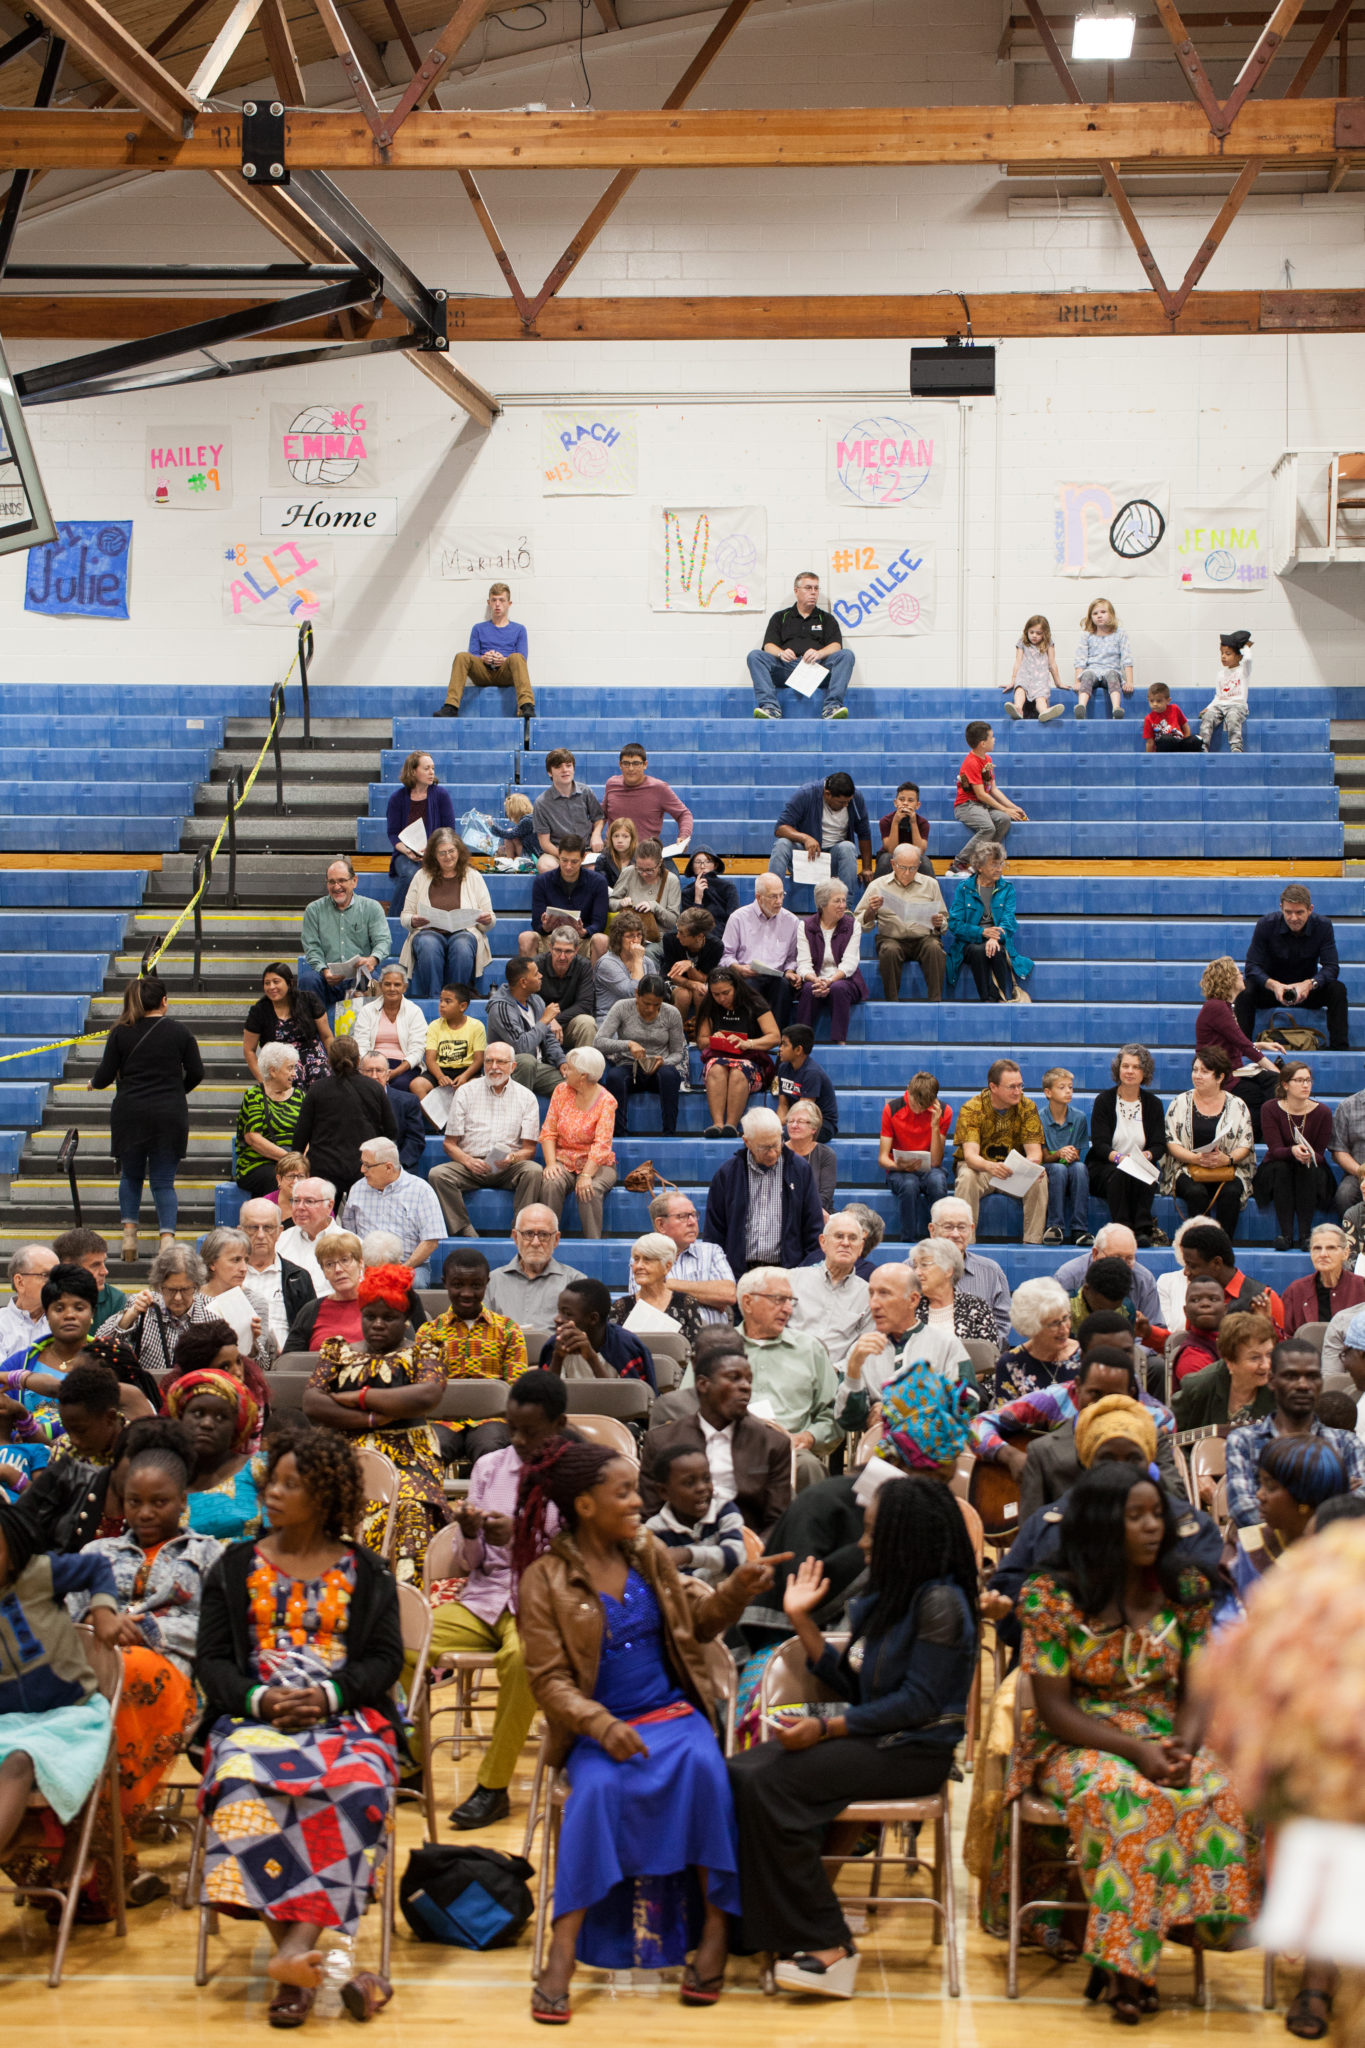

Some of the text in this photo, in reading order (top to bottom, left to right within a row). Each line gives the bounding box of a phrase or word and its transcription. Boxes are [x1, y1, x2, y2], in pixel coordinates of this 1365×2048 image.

[331, 403, 367, 431] #6
[283, 435, 368, 460] EMMA
[560, 422, 621, 452] RACH
[150, 444, 223, 469] HAILEY
[836, 438, 934, 469] MEGAN
[187, 468, 220, 493] #9
[544, 461, 573, 482] #13
[864, 469, 902, 503] #2
[281, 500, 377, 527] Home
[225, 543, 248, 567] #8
[1177, 528, 1259, 555] JENNA
[831, 546, 880, 573] #12
[28, 544, 122, 607] Julie
[229, 541, 319, 615] ALLI
[833, 548, 923, 628] BAILEE
